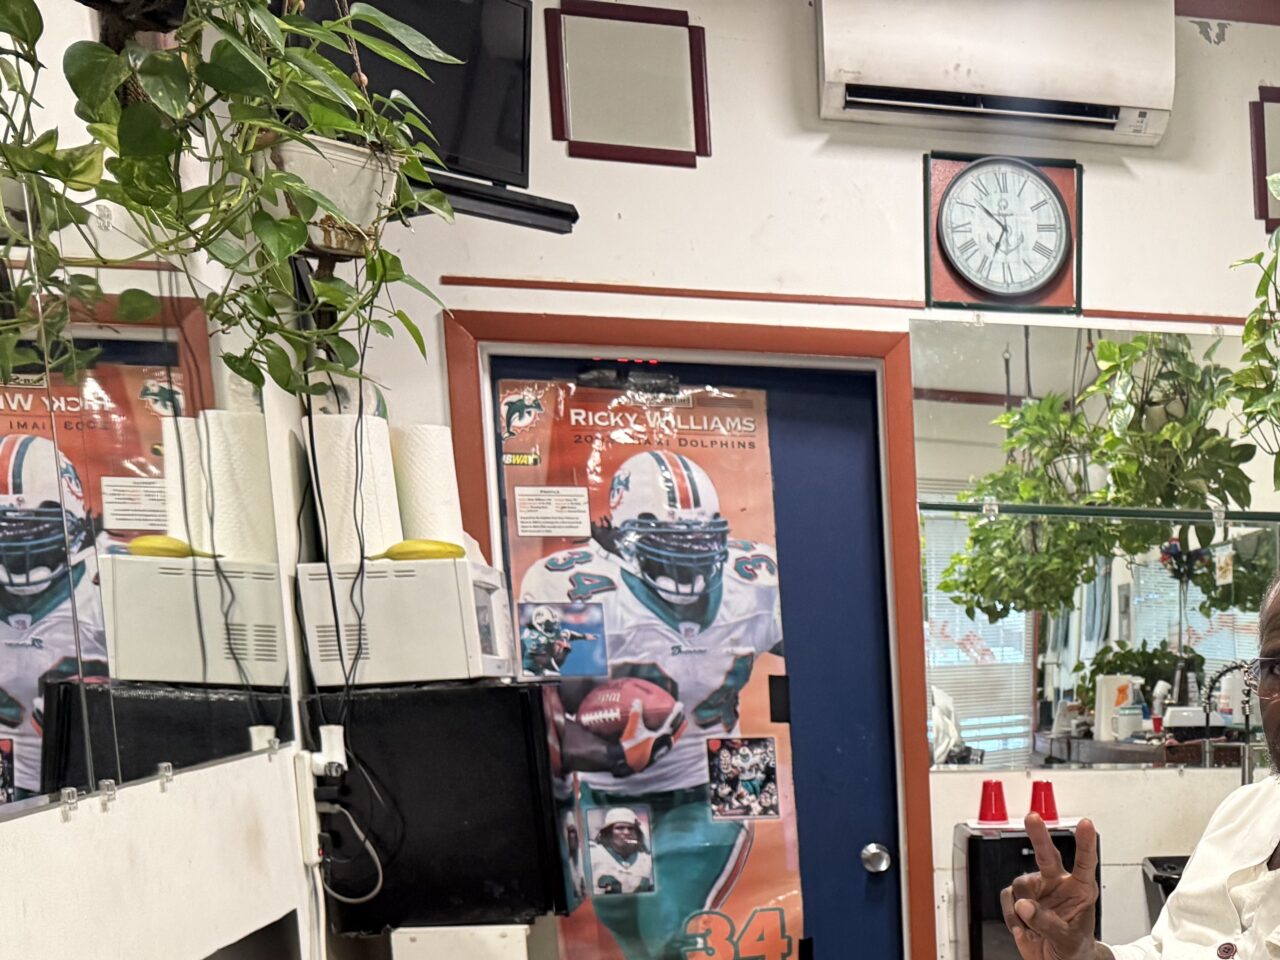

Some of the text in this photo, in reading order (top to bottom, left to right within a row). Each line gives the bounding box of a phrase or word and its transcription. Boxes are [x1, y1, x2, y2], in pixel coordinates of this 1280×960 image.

[569, 408, 757, 433] RICKY WILLIAMS
[678, 438, 757, 450] DOLPHINS
[503, 453, 540, 465] BWAY
